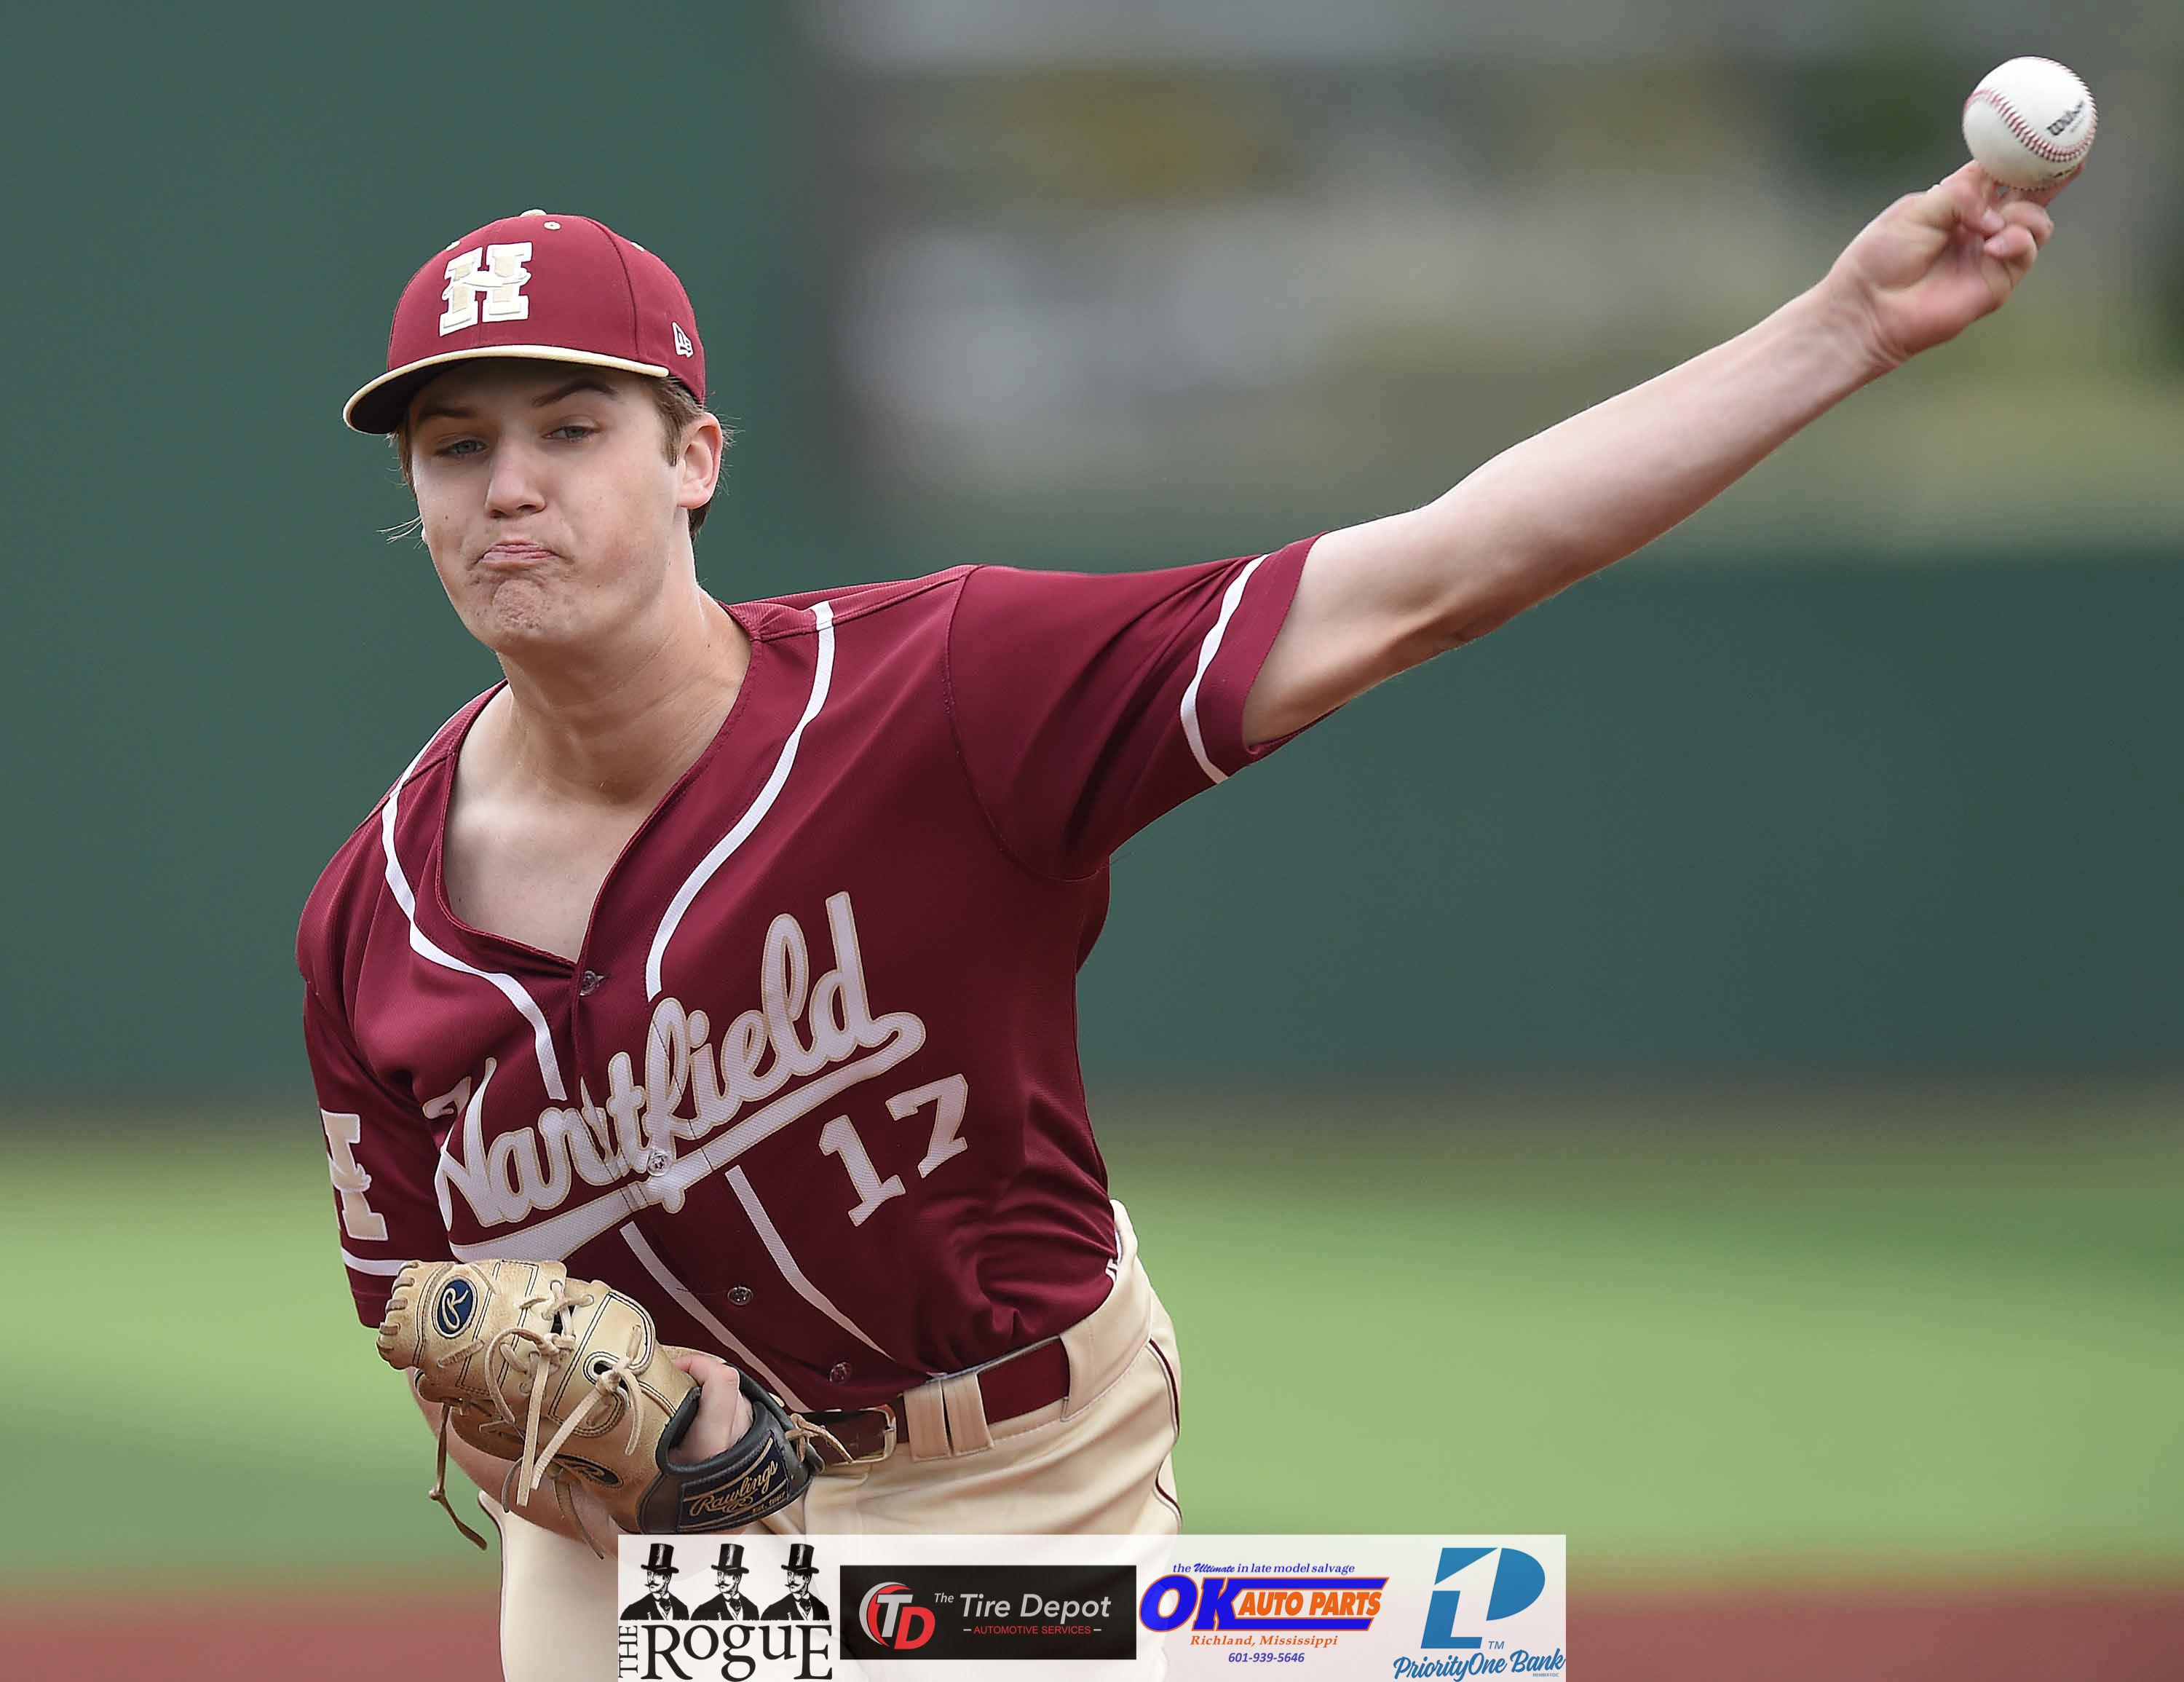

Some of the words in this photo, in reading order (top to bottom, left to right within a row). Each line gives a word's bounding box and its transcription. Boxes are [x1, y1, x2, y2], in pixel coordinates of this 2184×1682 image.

[440, 242, 532, 336] H
[819, 1073, 968, 1227] 17
[690, 1461, 778, 1516] Rawlings
